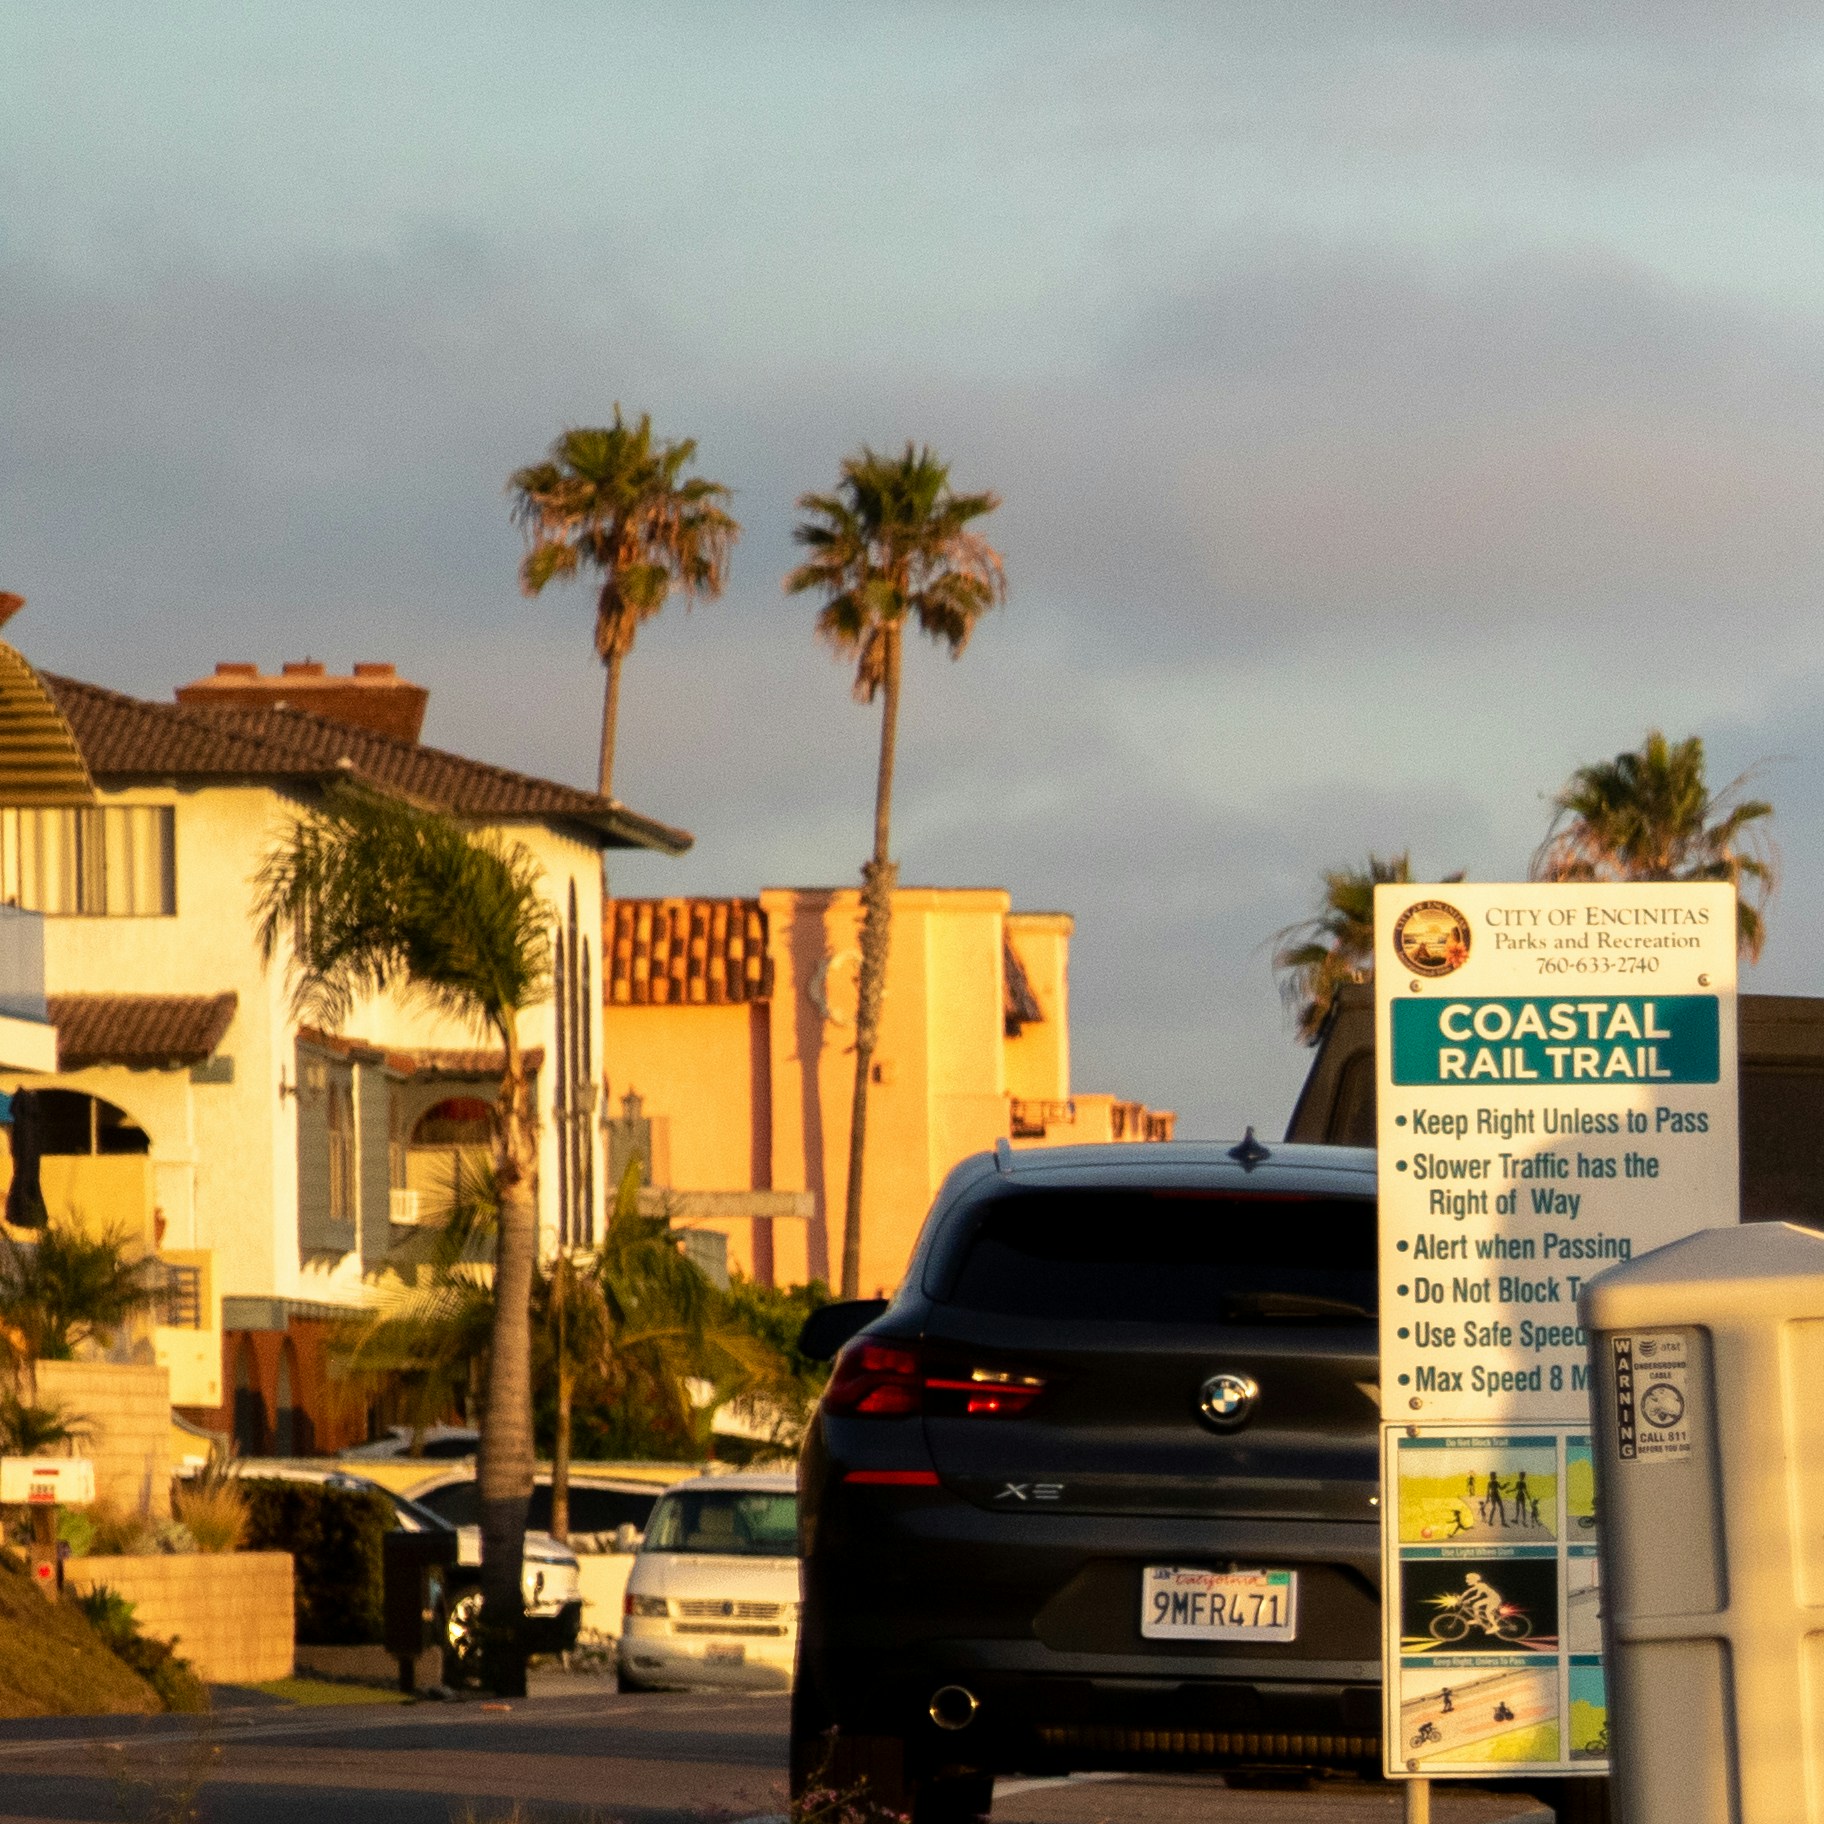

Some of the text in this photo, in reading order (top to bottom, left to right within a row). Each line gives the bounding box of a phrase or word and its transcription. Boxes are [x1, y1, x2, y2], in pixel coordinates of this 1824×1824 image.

[1486, 907, 1710, 926] CITY OF ENCINITAS
[1495, 931, 1701, 950] Parks and Recreation
[1535, 957, 1660, 975] 760-633-2740
[1438, 1002, 1672, 1042] COASTAL
[1438, 1046, 1672, 1080] RAIL TRAIL
[1412, 1107, 1709, 1141] Keep Right Unless to Pass
[1413, 1152, 1660, 1180] Slower Traffic has the
[1429, 1188, 1581, 1221] Right of Way
[1413, 1232, 1632, 1262] Alert when Passing
[1414, 1276, 1445, 1304] Do
[1452, 1276, 1491, 1304] Not
[1499, 1275, 1561, 1304] Block
[1414, 1321, 1456, 1349] Use
[1463, 1319, 1513, 1348] Safe
[1415, 1365, 1464, 1393] Max
[1470, 1364, 1542, 1398] Speed
[1549, 1364, 1564, 1392] 8
[1614, 1340, 1634, 1457] WARNING
[1640, 1431, 1687, 1443] CALL 811
[1153, 1591, 1284, 1628] 9MFR471
